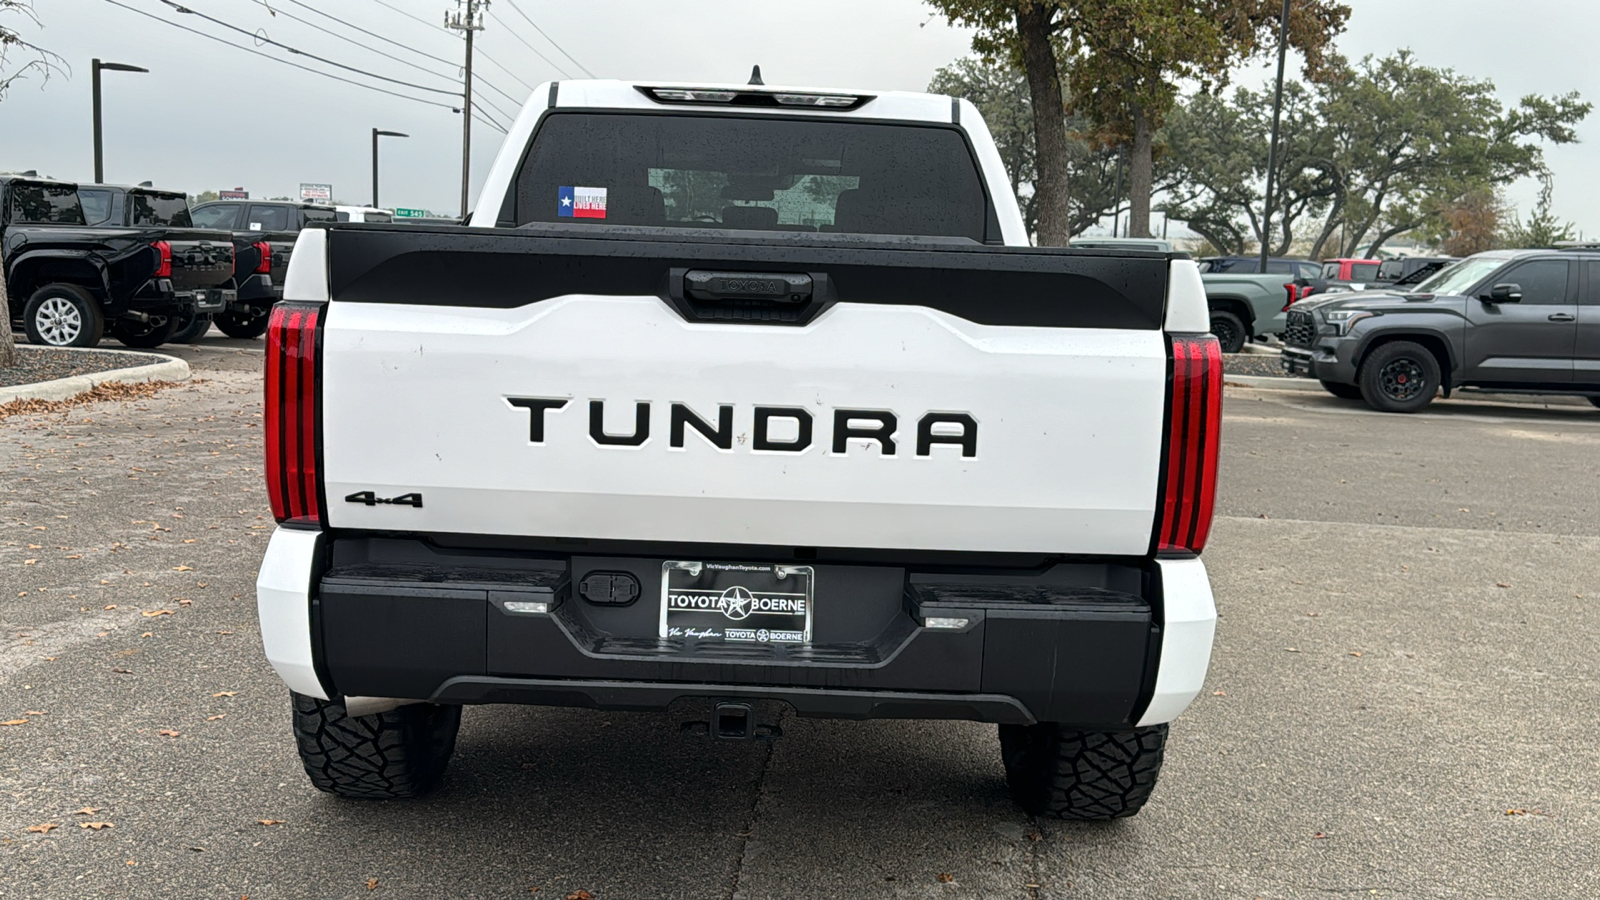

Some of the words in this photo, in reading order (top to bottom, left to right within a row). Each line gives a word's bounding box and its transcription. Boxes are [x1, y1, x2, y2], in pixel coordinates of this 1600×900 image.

[719, 279, 777, 292] TOYOTA
[502, 396, 980, 460] TUNDRA
[345, 490, 423, 508] 4x4
[706, 563, 771, 572] VicVaughanToyota.com
[668, 595, 728, 609] TOYOTA
[752, 598, 805, 611] BOERNE
[725, 631, 756, 639] TOYOTA
[770, 632, 803, 640] BOERNE
